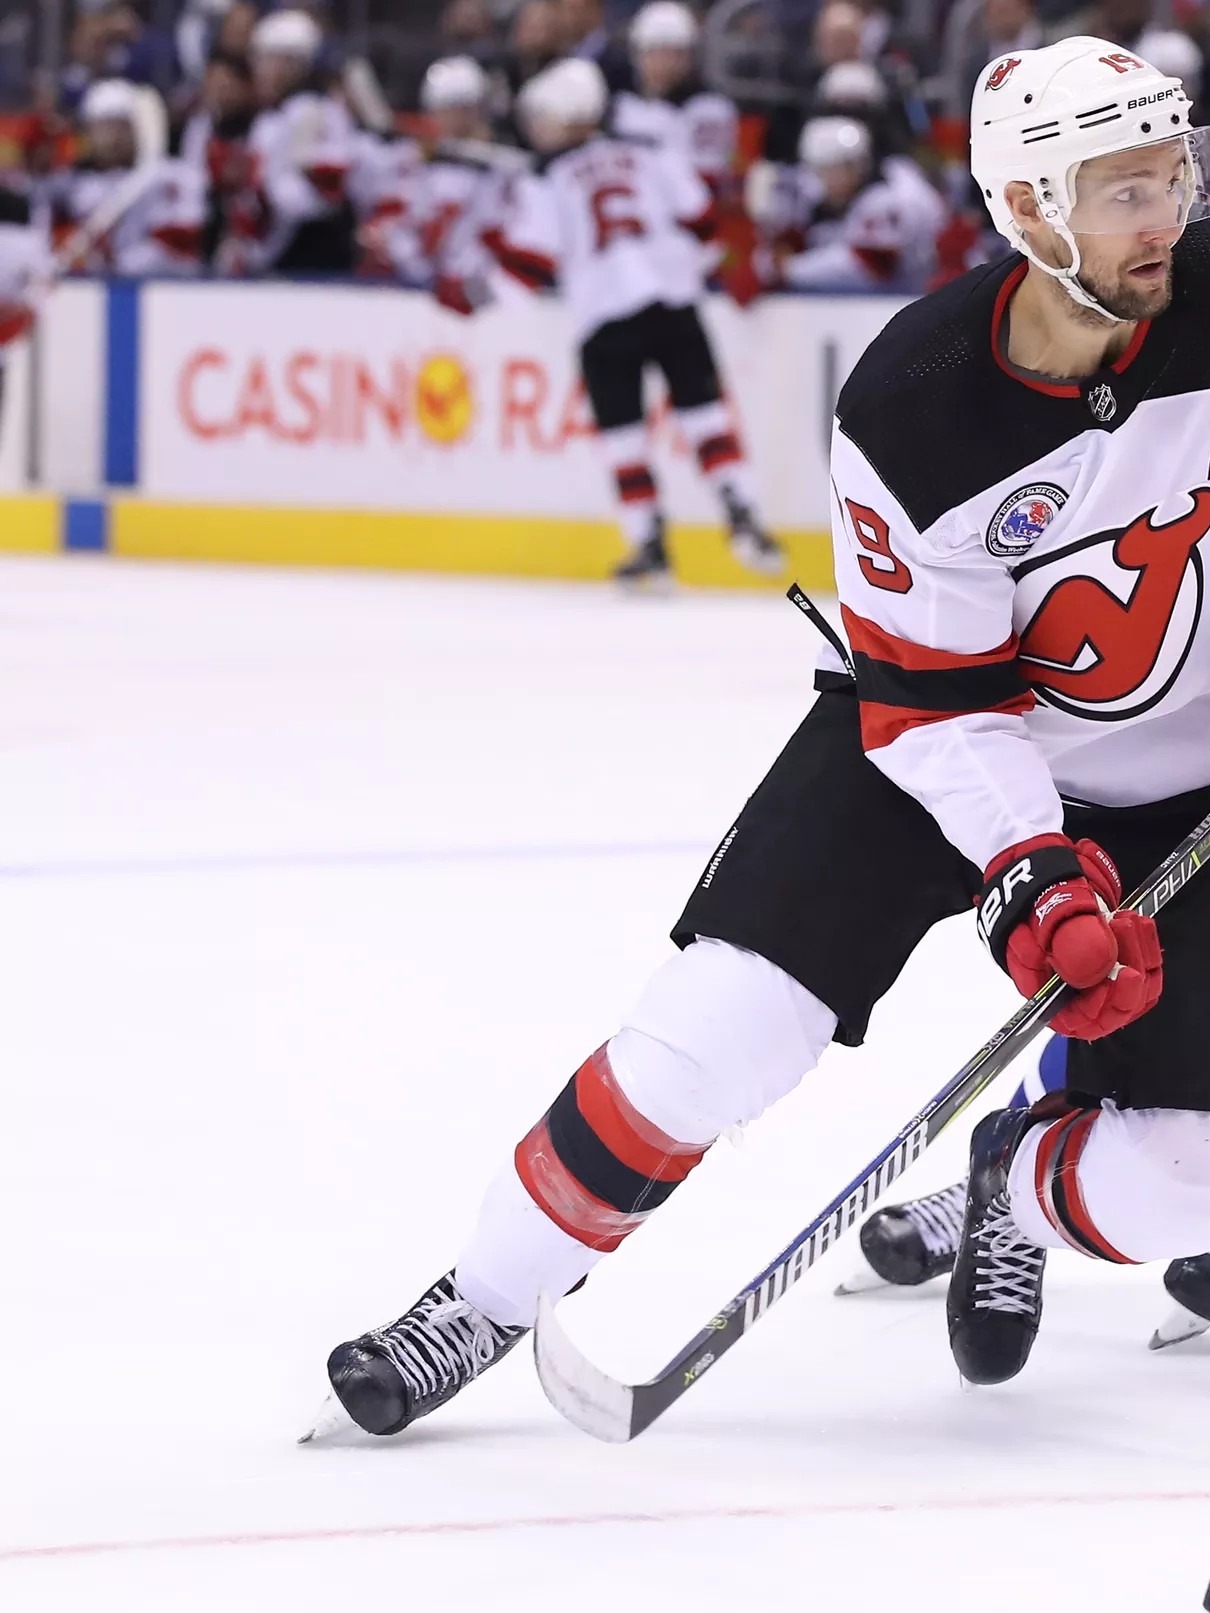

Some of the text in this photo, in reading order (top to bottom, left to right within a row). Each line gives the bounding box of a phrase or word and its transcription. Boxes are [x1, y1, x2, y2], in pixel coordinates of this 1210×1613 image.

[1099, 53, 1144, 73] 19
[1127, 89, 1174, 110] BAUER
[840, 491, 913, 595] 9
[745, 1119, 929, 1334] WARRIOR
